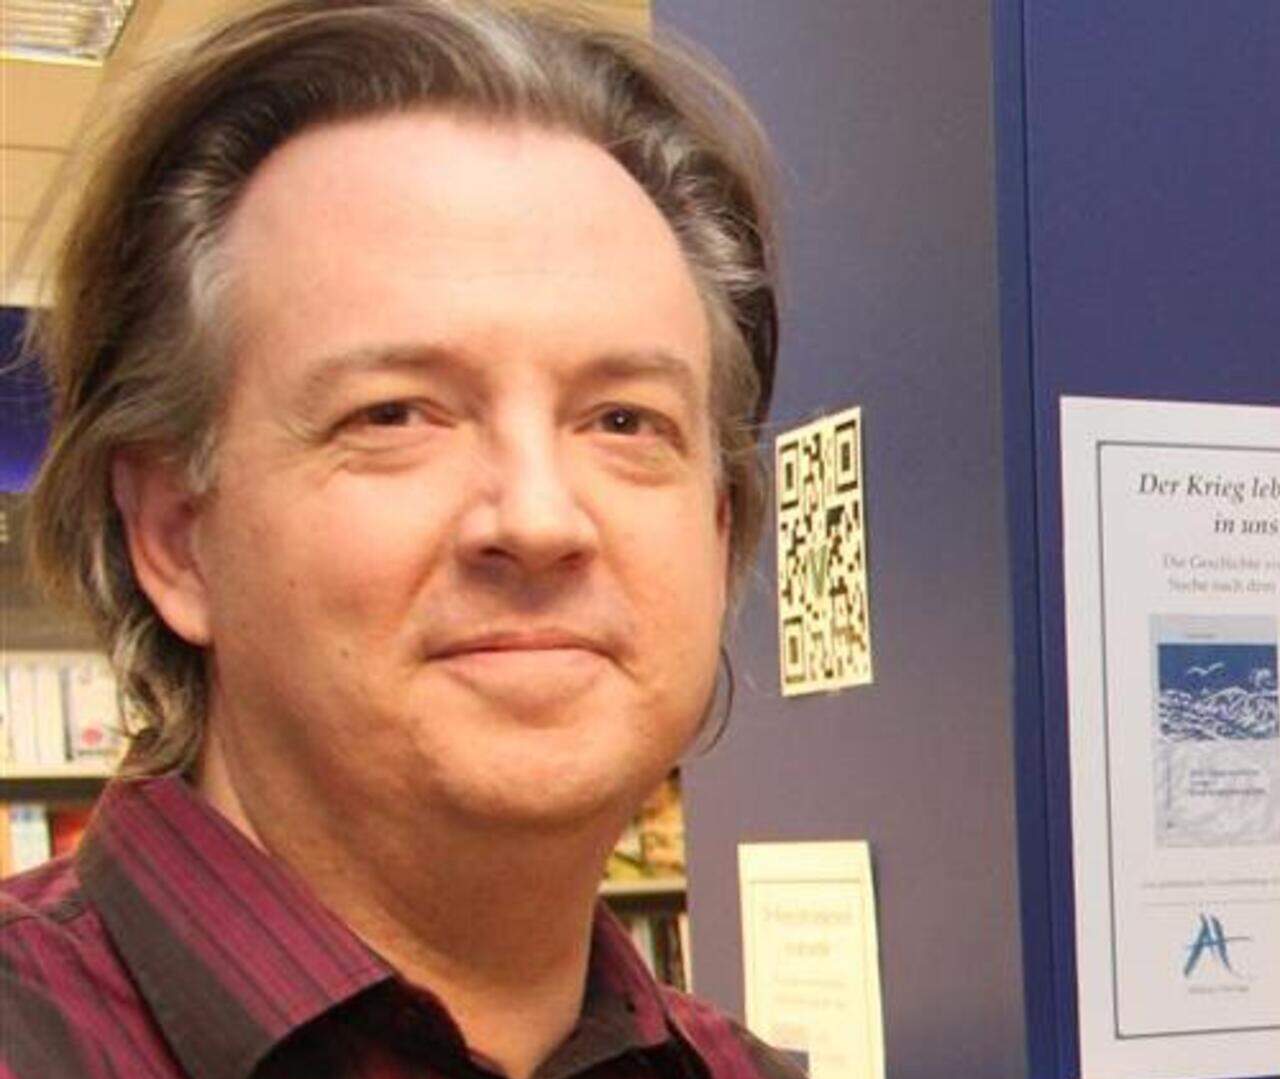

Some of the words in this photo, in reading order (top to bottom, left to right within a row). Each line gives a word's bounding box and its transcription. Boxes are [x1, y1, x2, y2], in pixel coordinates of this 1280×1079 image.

[1139, 473, 1180, 495] Der
[1187, 474, 1245, 502] Krieg
[1213, 514, 1235, 534] in
[1241, 518, 1279, 535] uns
